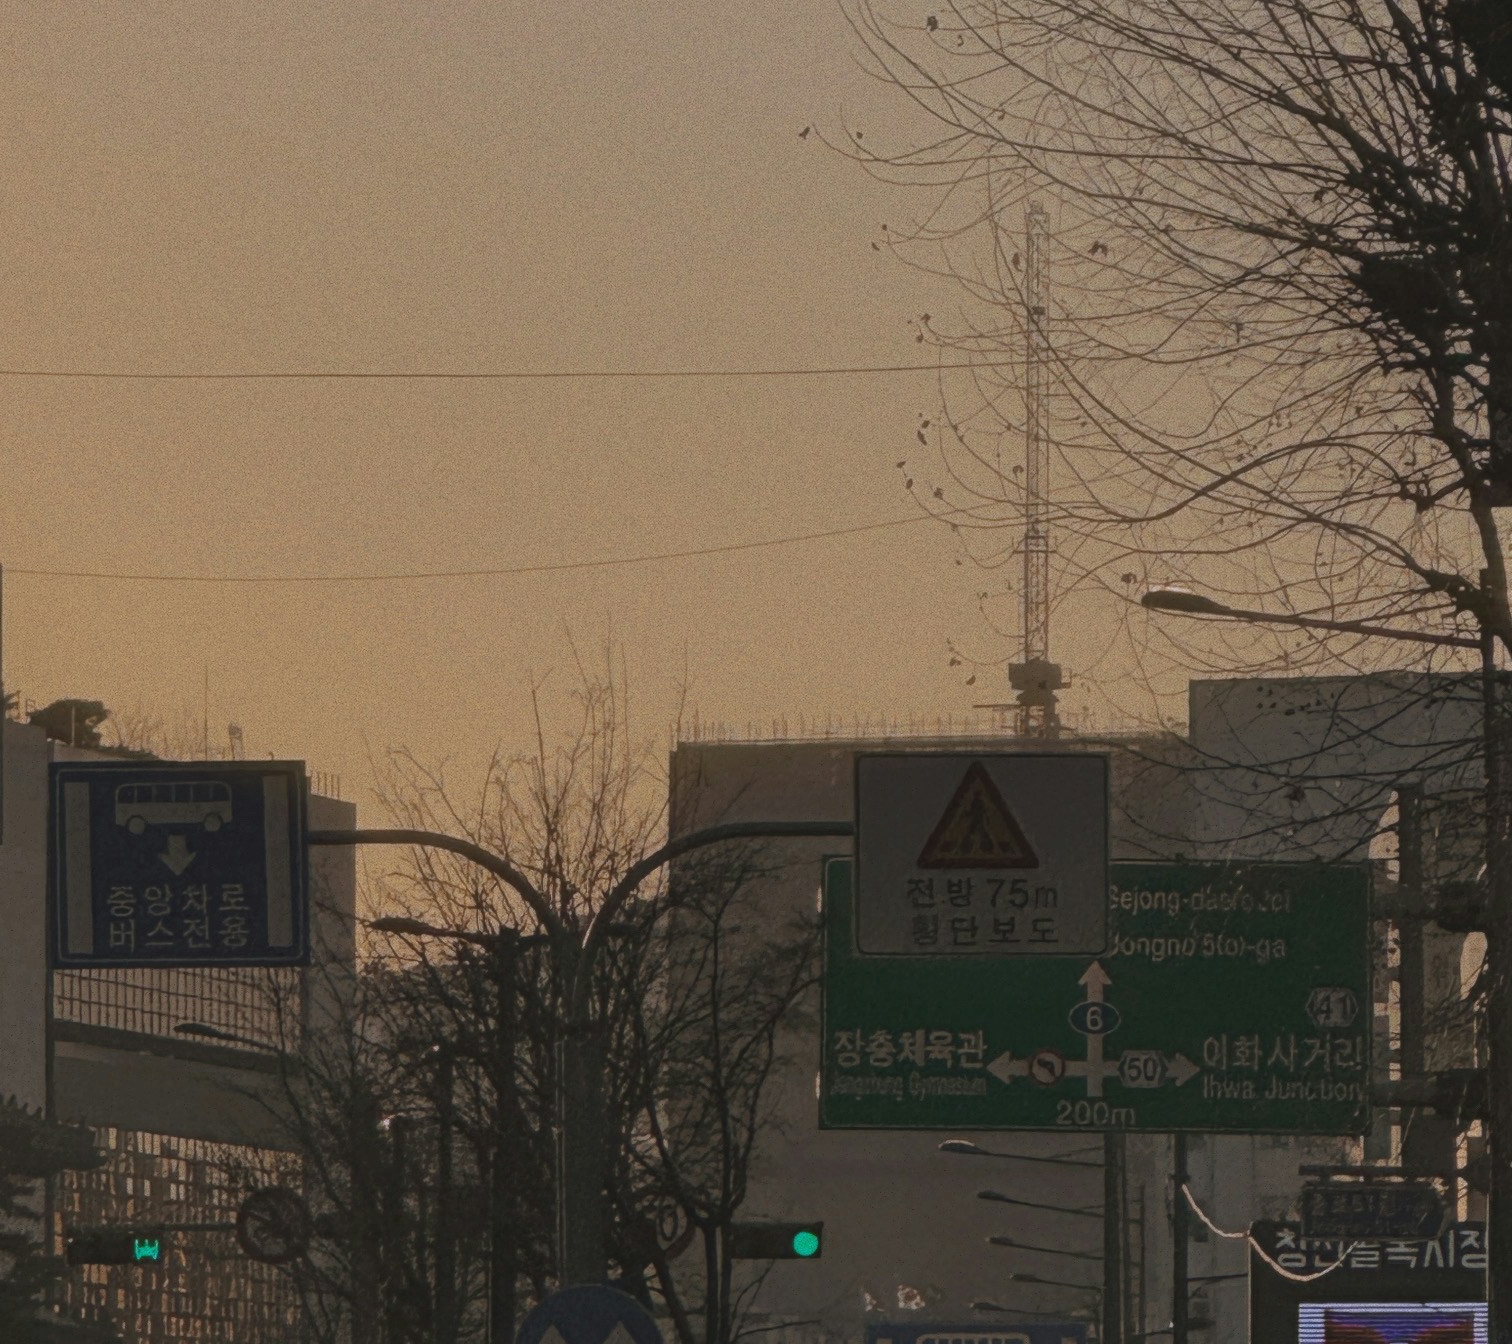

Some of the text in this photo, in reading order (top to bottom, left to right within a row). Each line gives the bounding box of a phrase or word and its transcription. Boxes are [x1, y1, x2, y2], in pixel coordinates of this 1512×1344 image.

[107, 882, 251, 918] 중앙차로
[907, 877, 1058, 908] 전방 75m
[108, 915, 250, 954] 버스전용
[911, 913, 1059, 946] 횡단보도
[1085, 1005, 1104, 1031] 6
[834, 1027, 988, 1070] 장충체육관
[1203, 1031, 1363, 1073] 이화사거리
[1127, 1055, 1158, 1081] 50
[1056, 1100, 1136, 1125] 200m
